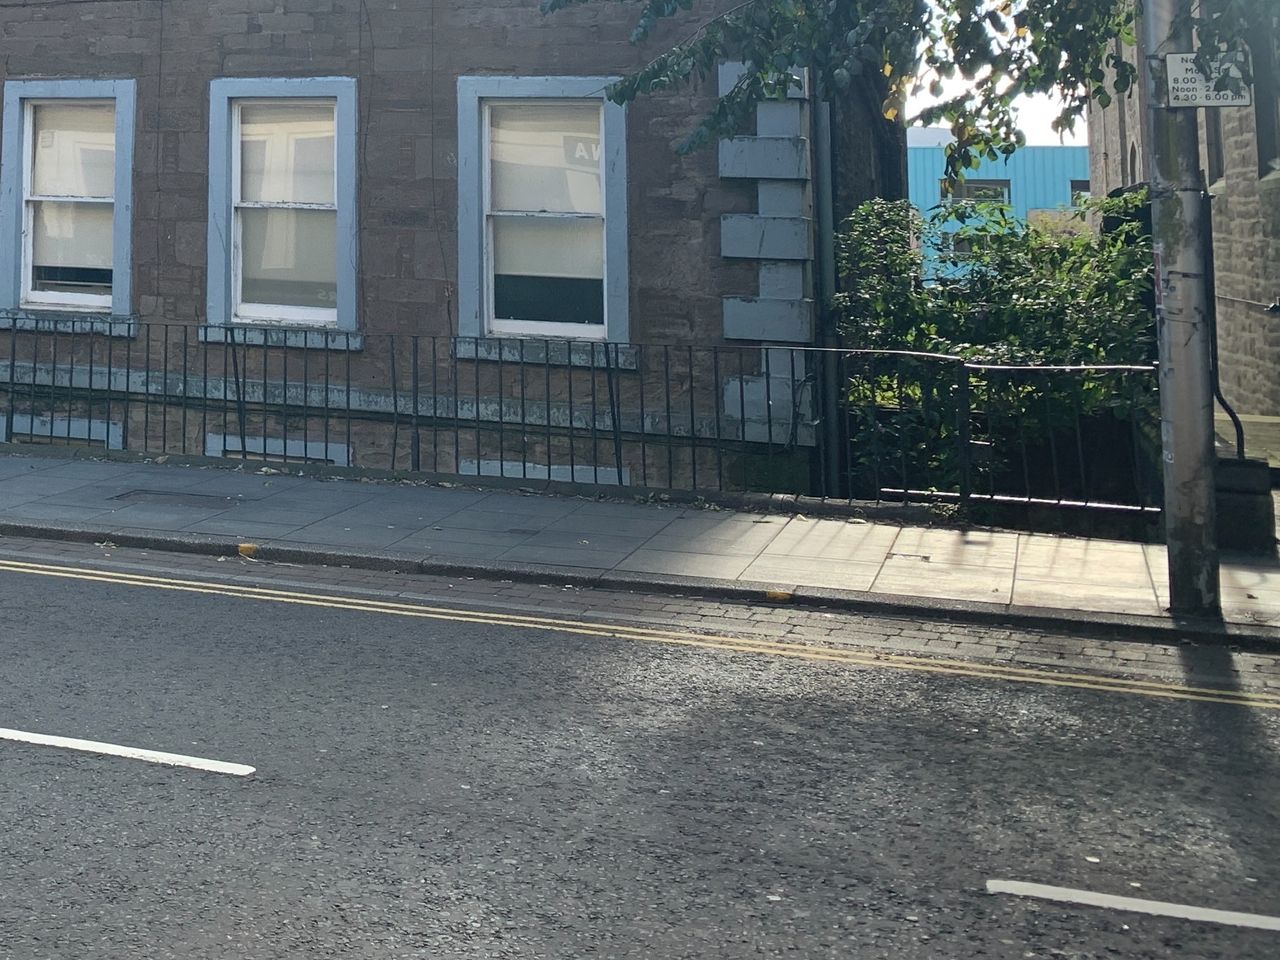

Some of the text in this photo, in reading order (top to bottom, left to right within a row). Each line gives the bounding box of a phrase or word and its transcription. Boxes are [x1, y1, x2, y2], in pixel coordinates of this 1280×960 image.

[1173, 76, 1197, 85] 8.00
[1173, 94, 1198, 102] 4.30
[1205, 93, 1229, 101] 6.00
[1232, 93, 1246, 102] pm
